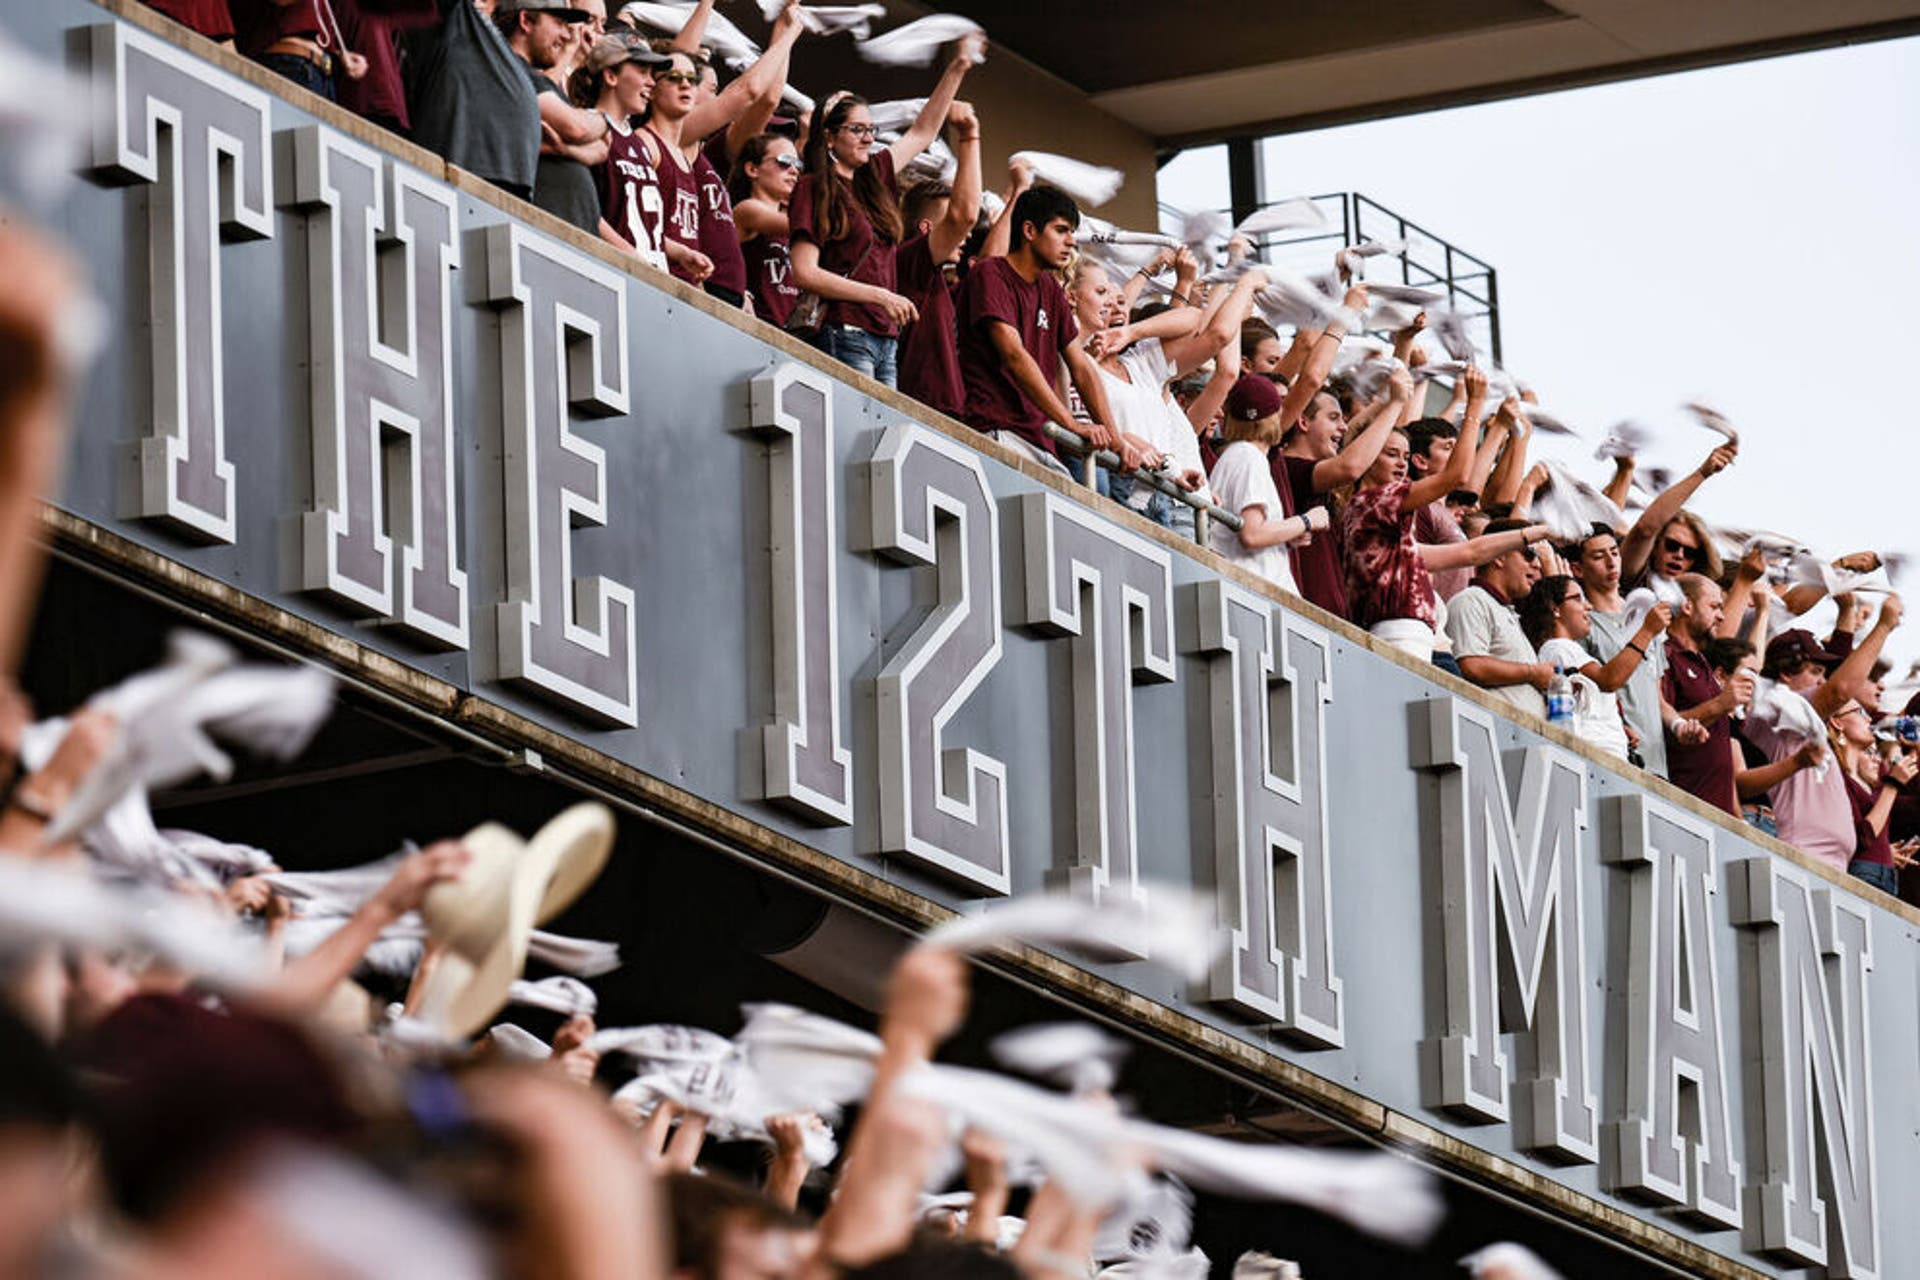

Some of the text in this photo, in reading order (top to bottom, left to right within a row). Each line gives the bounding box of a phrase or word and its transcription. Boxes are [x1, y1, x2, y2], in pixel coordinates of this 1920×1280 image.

[94, 20, 1881, 1280] THE 12TH MAN
